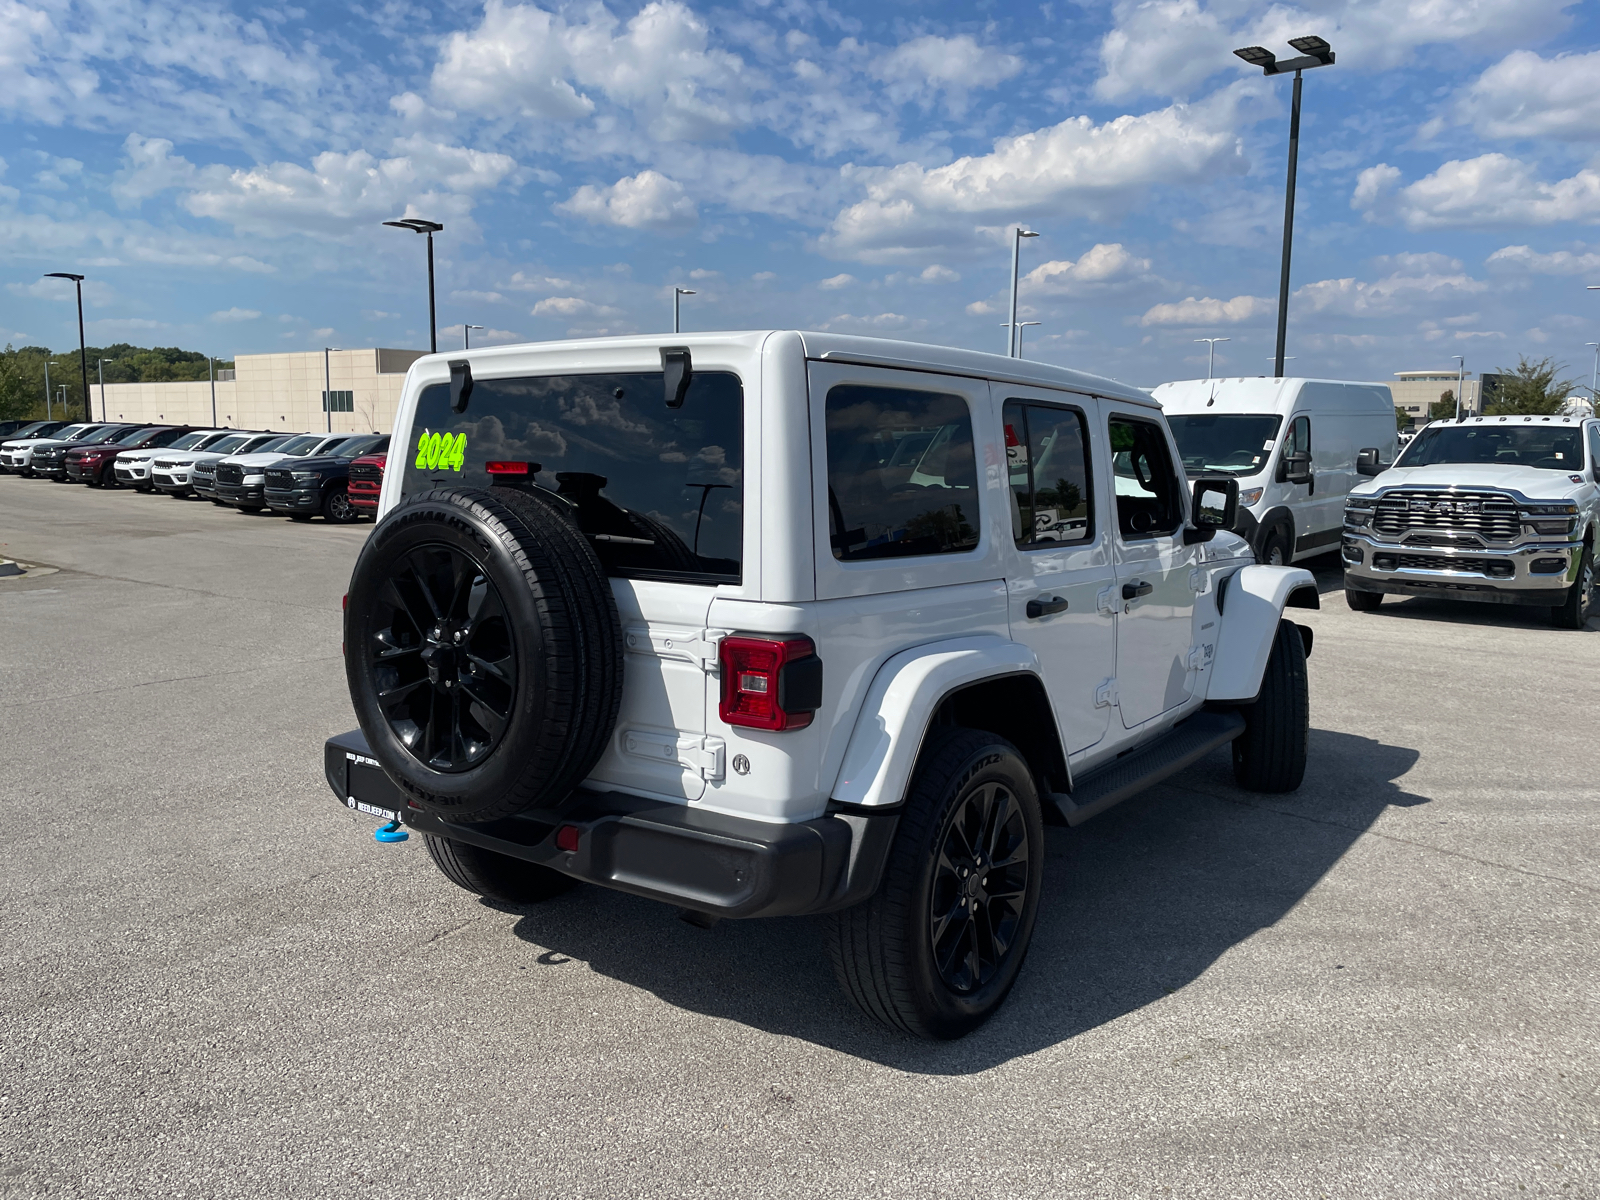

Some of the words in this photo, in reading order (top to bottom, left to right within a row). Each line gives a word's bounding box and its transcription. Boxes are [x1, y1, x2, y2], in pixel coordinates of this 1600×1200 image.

[415, 432, 467, 472] 2024
[1409, 500, 1481, 515] RAM
[402, 779, 463, 806] NEXEN
